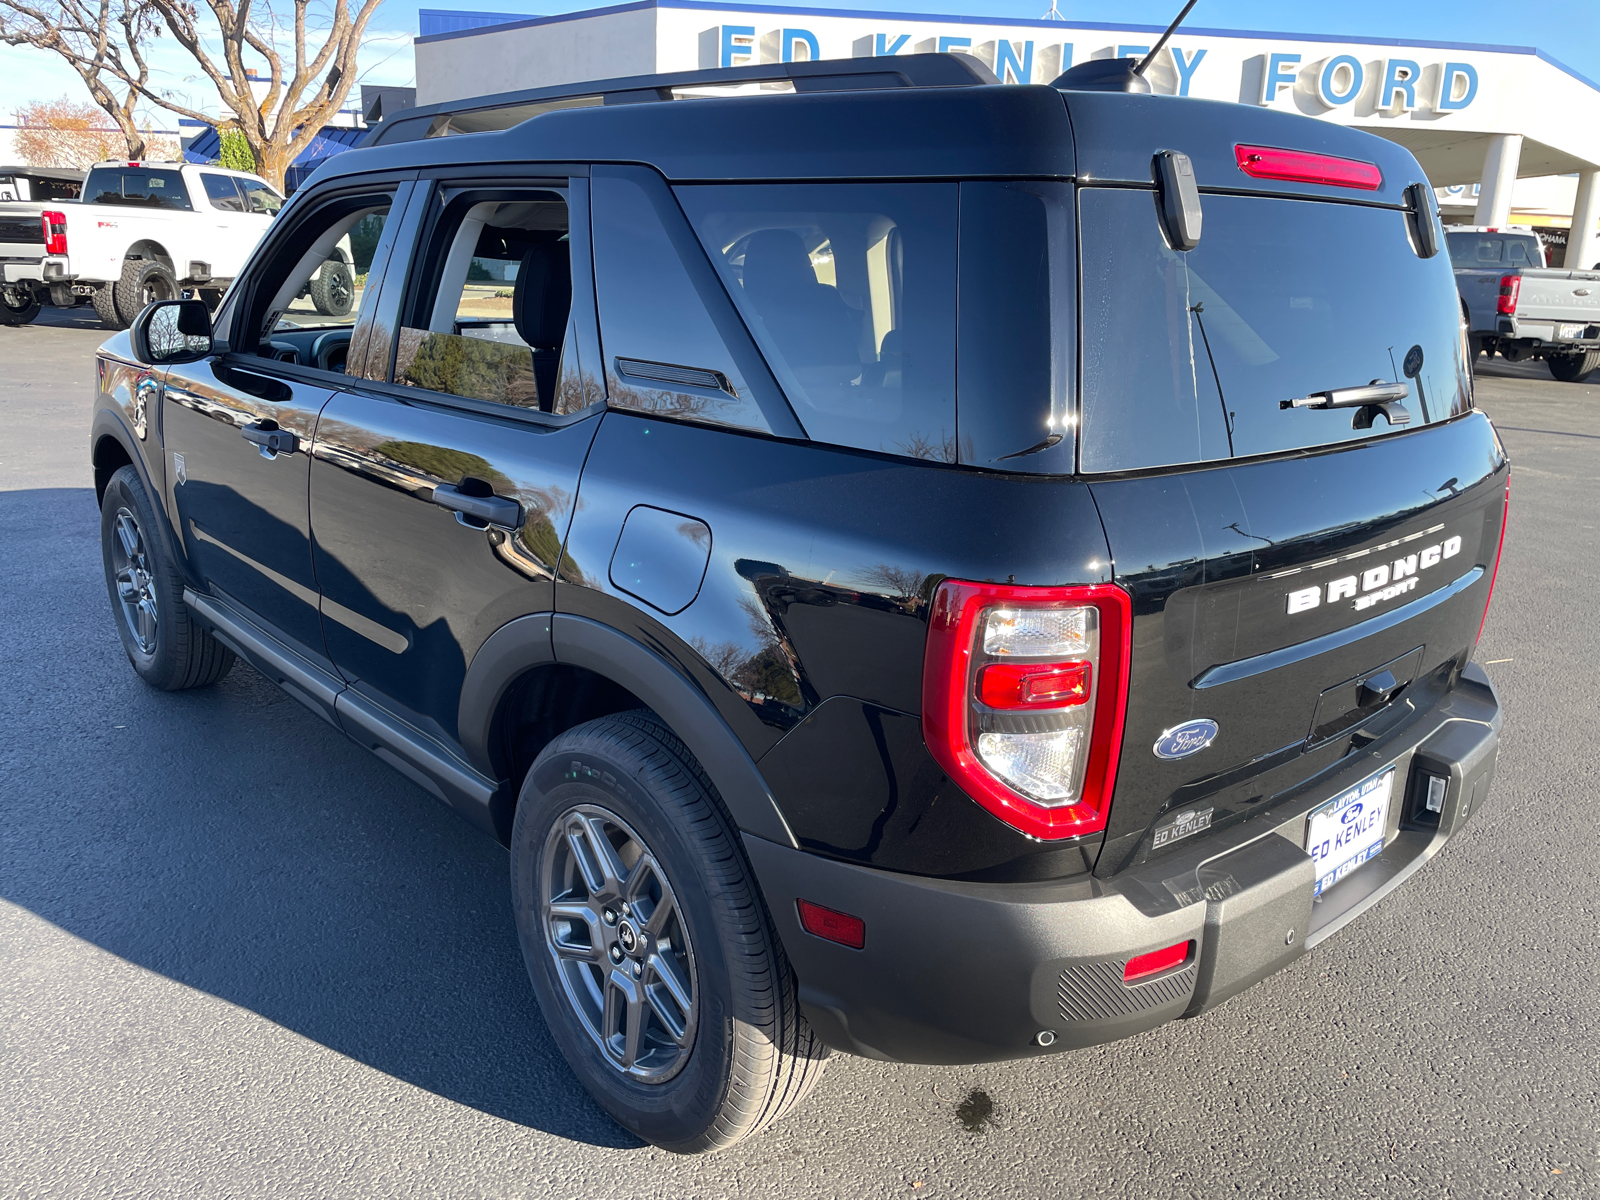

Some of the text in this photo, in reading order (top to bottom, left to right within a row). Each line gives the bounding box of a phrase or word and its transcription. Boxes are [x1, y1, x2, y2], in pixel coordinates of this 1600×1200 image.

[875, 32, 1208, 97] KNY
[1265, 52, 1479, 110] FORD
[1285, 535, 1462, 615] BRONCO
[1351, 576, 1419, 611] SPORT
[1154, 830, 1169, 846] ED
[1171, 812, 1213, 839] KENLEY
[1311, 839, 1330, 863] ED
[1335, 804, 1384, 851] KENLEY
[1321, 872, 1335, 891] ED
[1335, 848, 1369, 880] KENLEY
